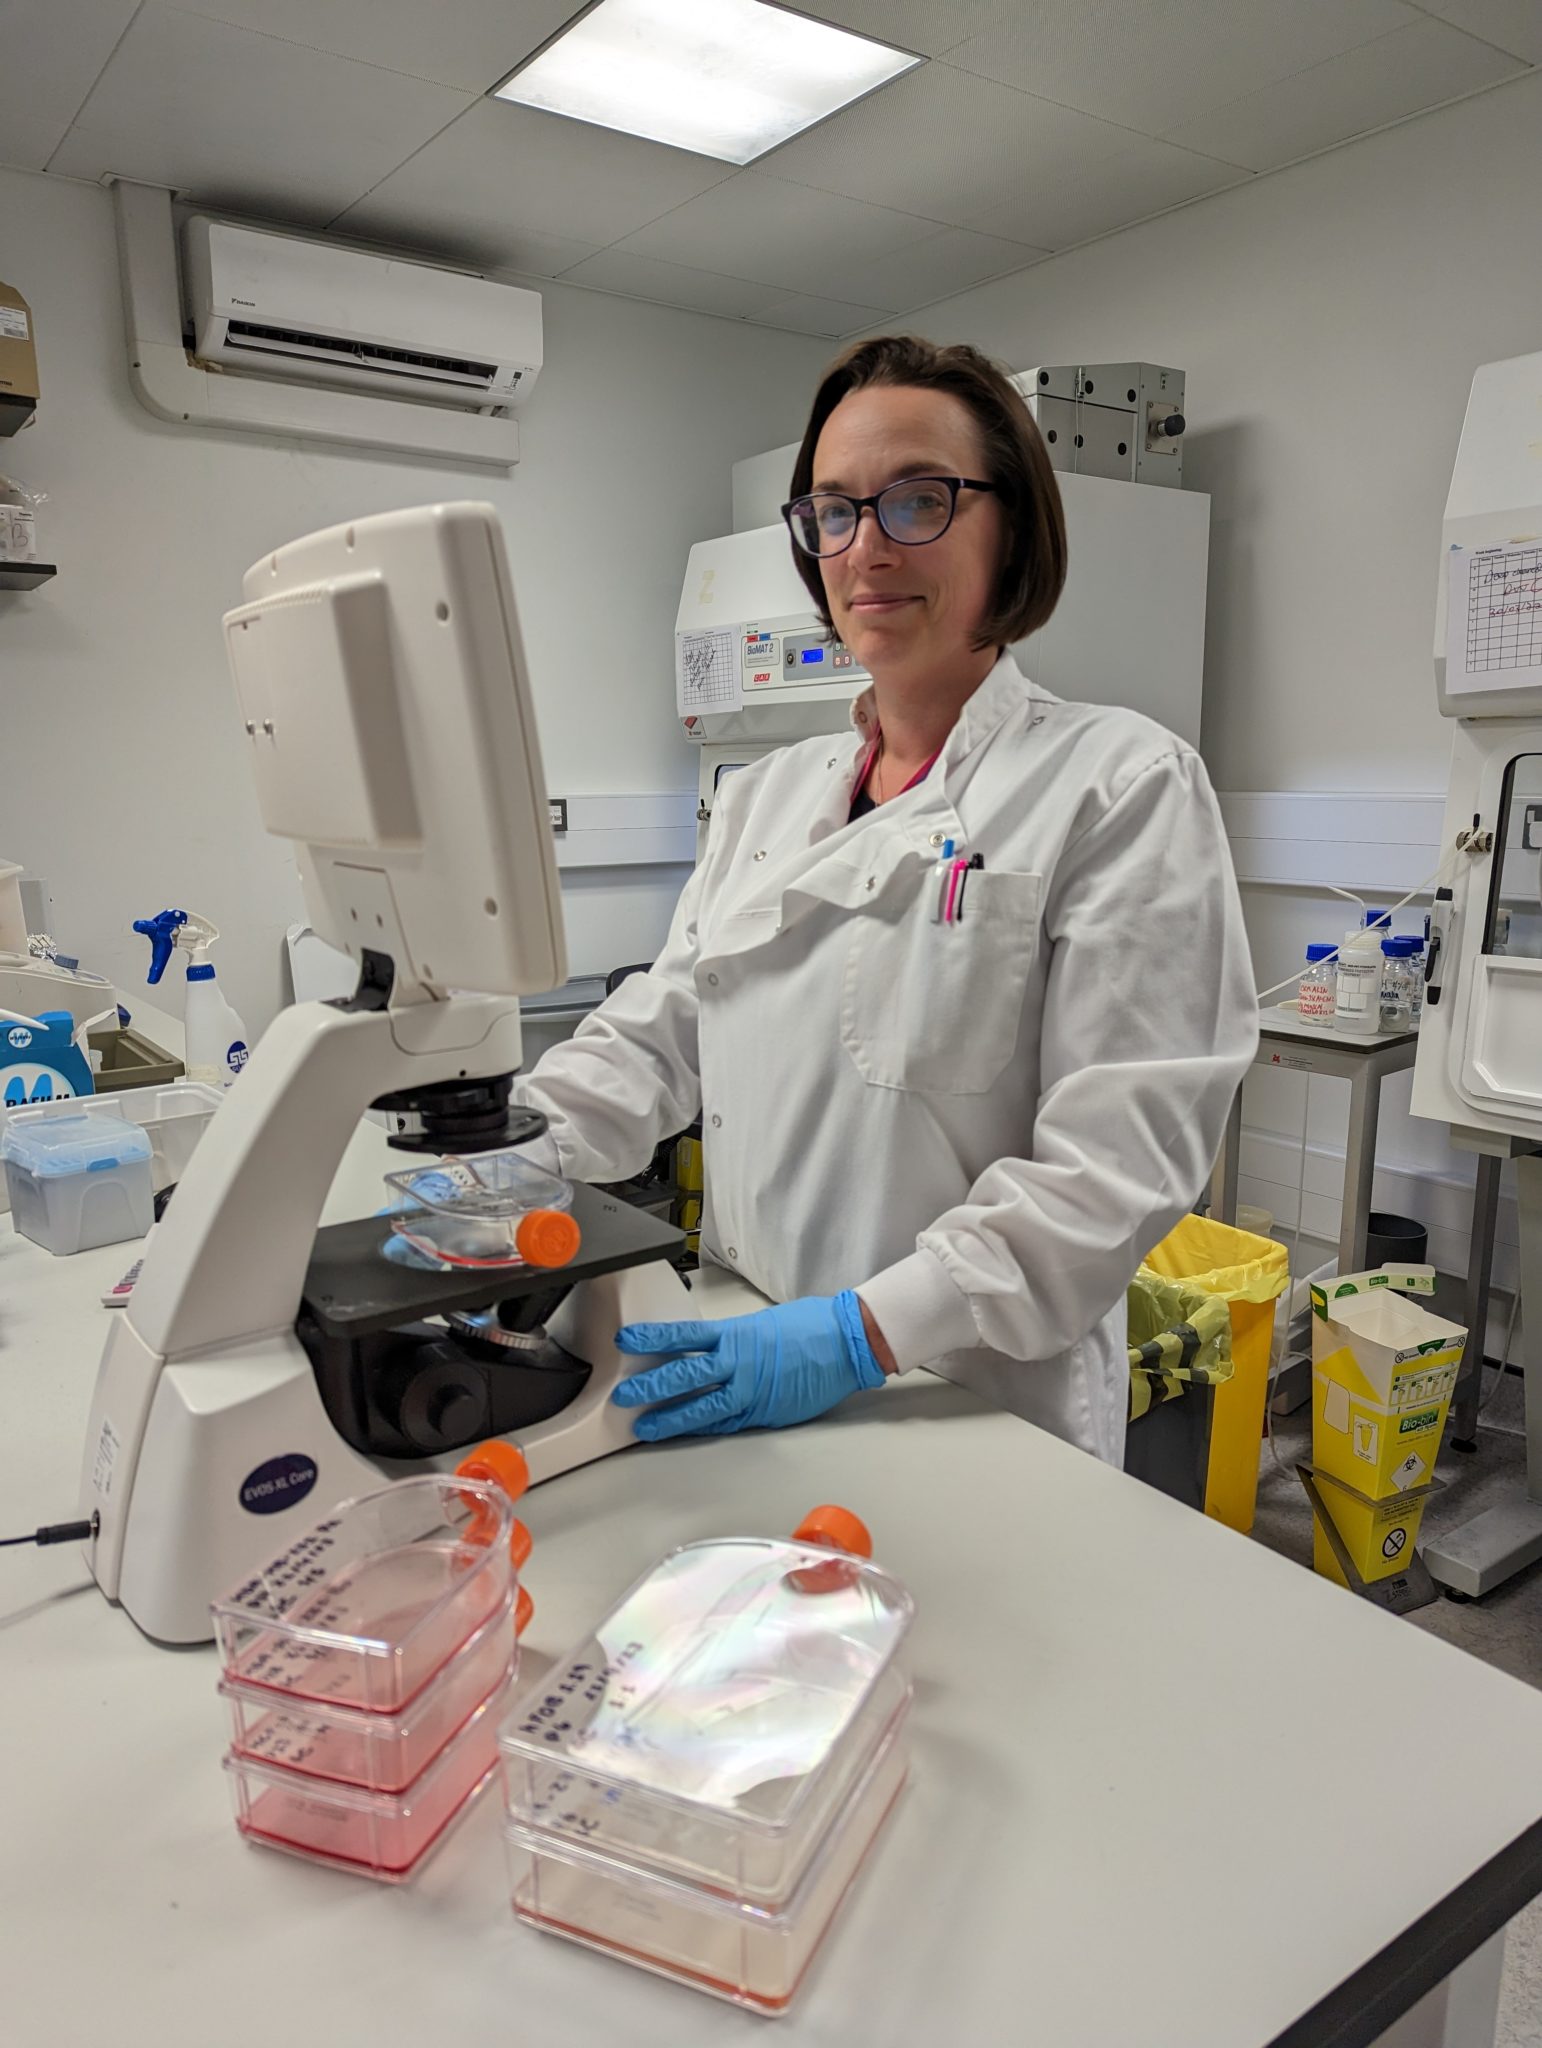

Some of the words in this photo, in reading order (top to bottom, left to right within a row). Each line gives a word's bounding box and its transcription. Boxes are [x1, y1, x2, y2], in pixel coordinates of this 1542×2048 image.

[747, 643, 768, 655] BioMAT
[769, 642, 774, 653] 2
[1402, 1414, 1434, 1431] Bio-bin
[244, 1480, 274, 1502] EVOS
[289, 1468, 315, 1486] Core
